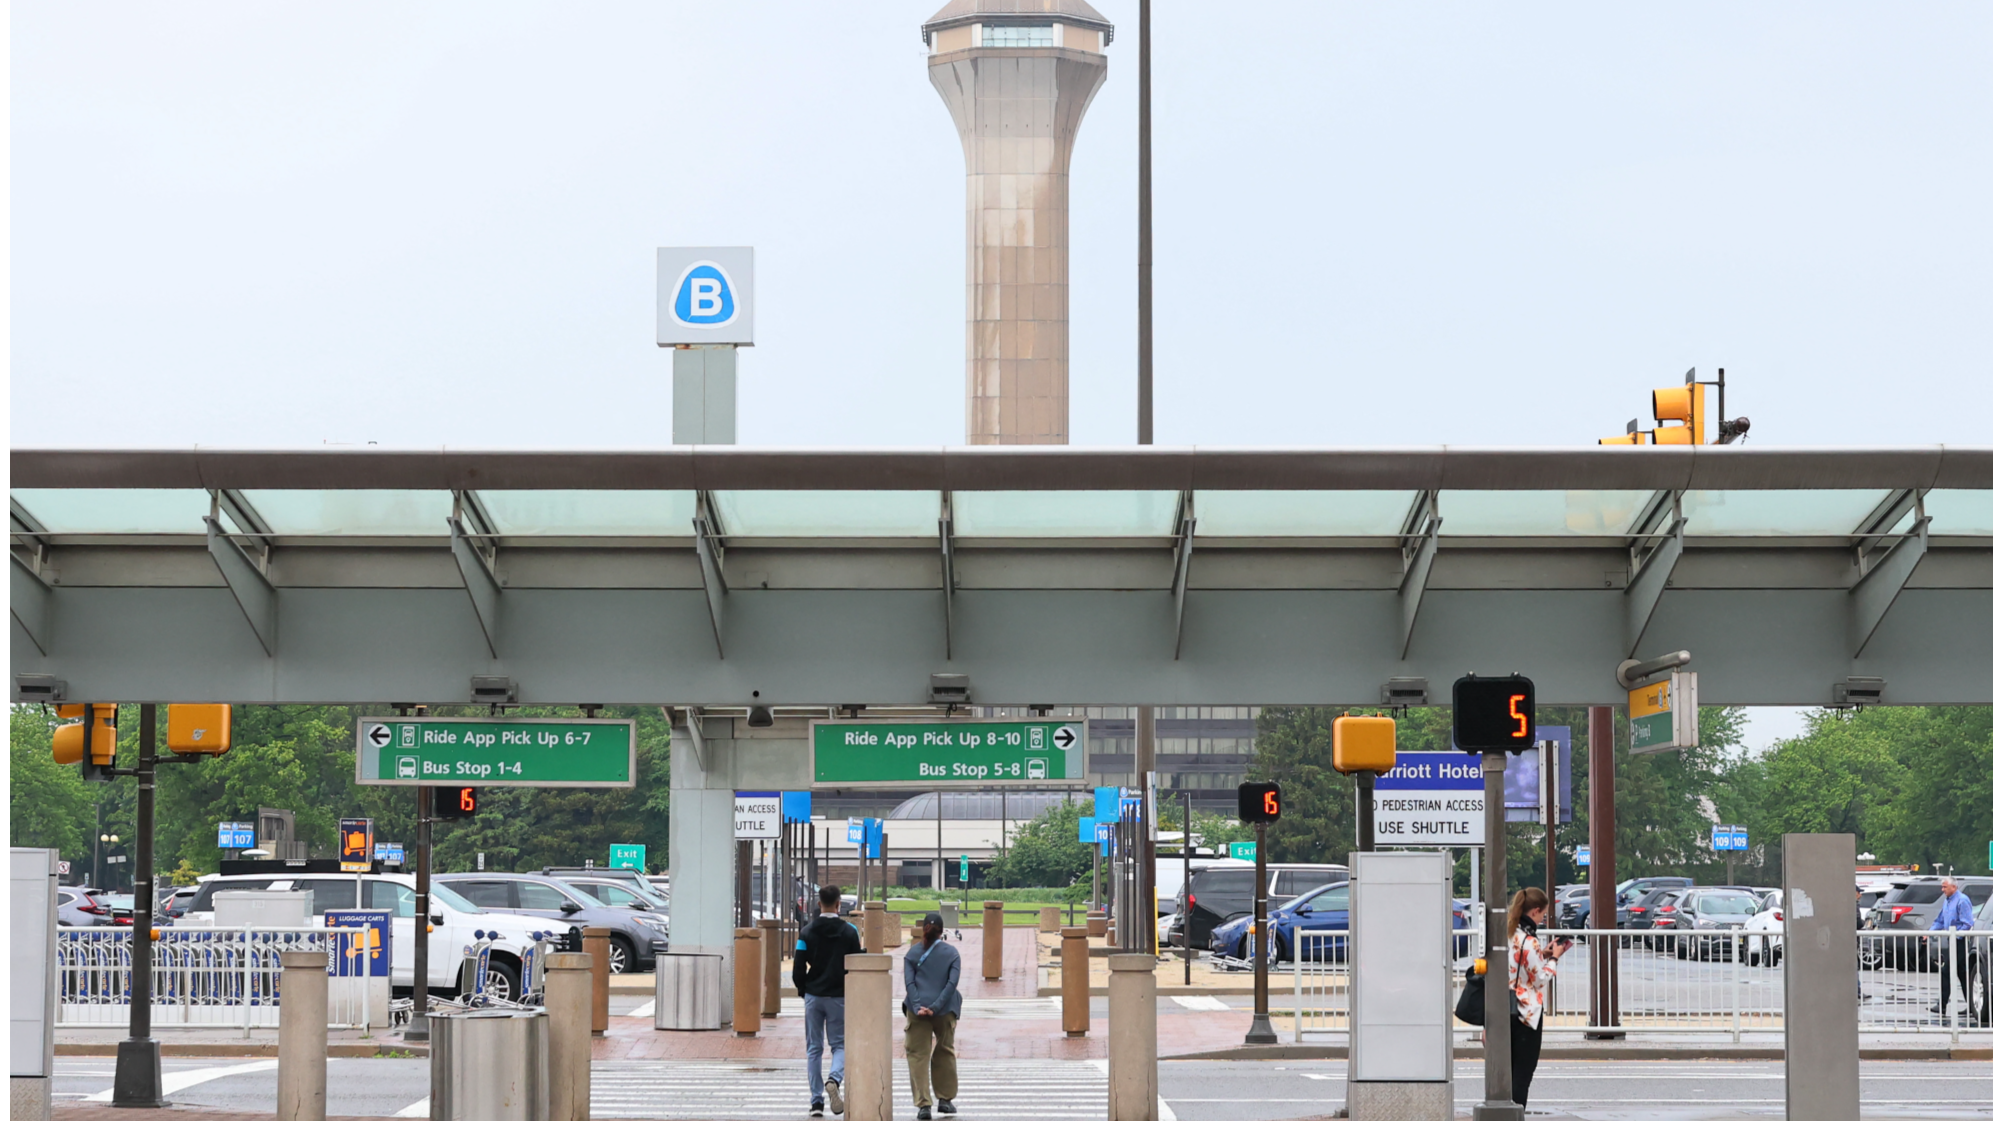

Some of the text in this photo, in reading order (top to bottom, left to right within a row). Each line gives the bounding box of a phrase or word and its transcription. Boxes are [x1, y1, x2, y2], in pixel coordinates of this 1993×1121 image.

[691, 277, 724, 316] B
[1509, 694, 1527, 737] 5
[424, 731, 591, 748] Ride App Pick Up 6-7
[845, 732, 1021, 748] Ride App Pick Up 8-10
[423, 761, 522, 777] Bus Stop 1-4
[919, 763, 1021, 778] Bus Stop 5-8
[1375, 763, 1484, 779] rriott Hotel
[461, 788, 475, 811] 15
[1264, 791, 1278, 815] 15
[1382, 800, 1441, 811] PEDESTRIAN
[1446, 800, 1484, 811] ACCESS
[748, 805, 776, 814] ACCESS
[735, 821, 765, 831] UTTLE
[1379, 821, 1470, 834] USE SHUTTLE
[234, 834, 252, 845] 107
[849, 829, 862, 840] 108
[1715, 836, 1730, 847] 109
[1733, 836, 1747, 847] 109
[617, 849, 638, 858] Exit
